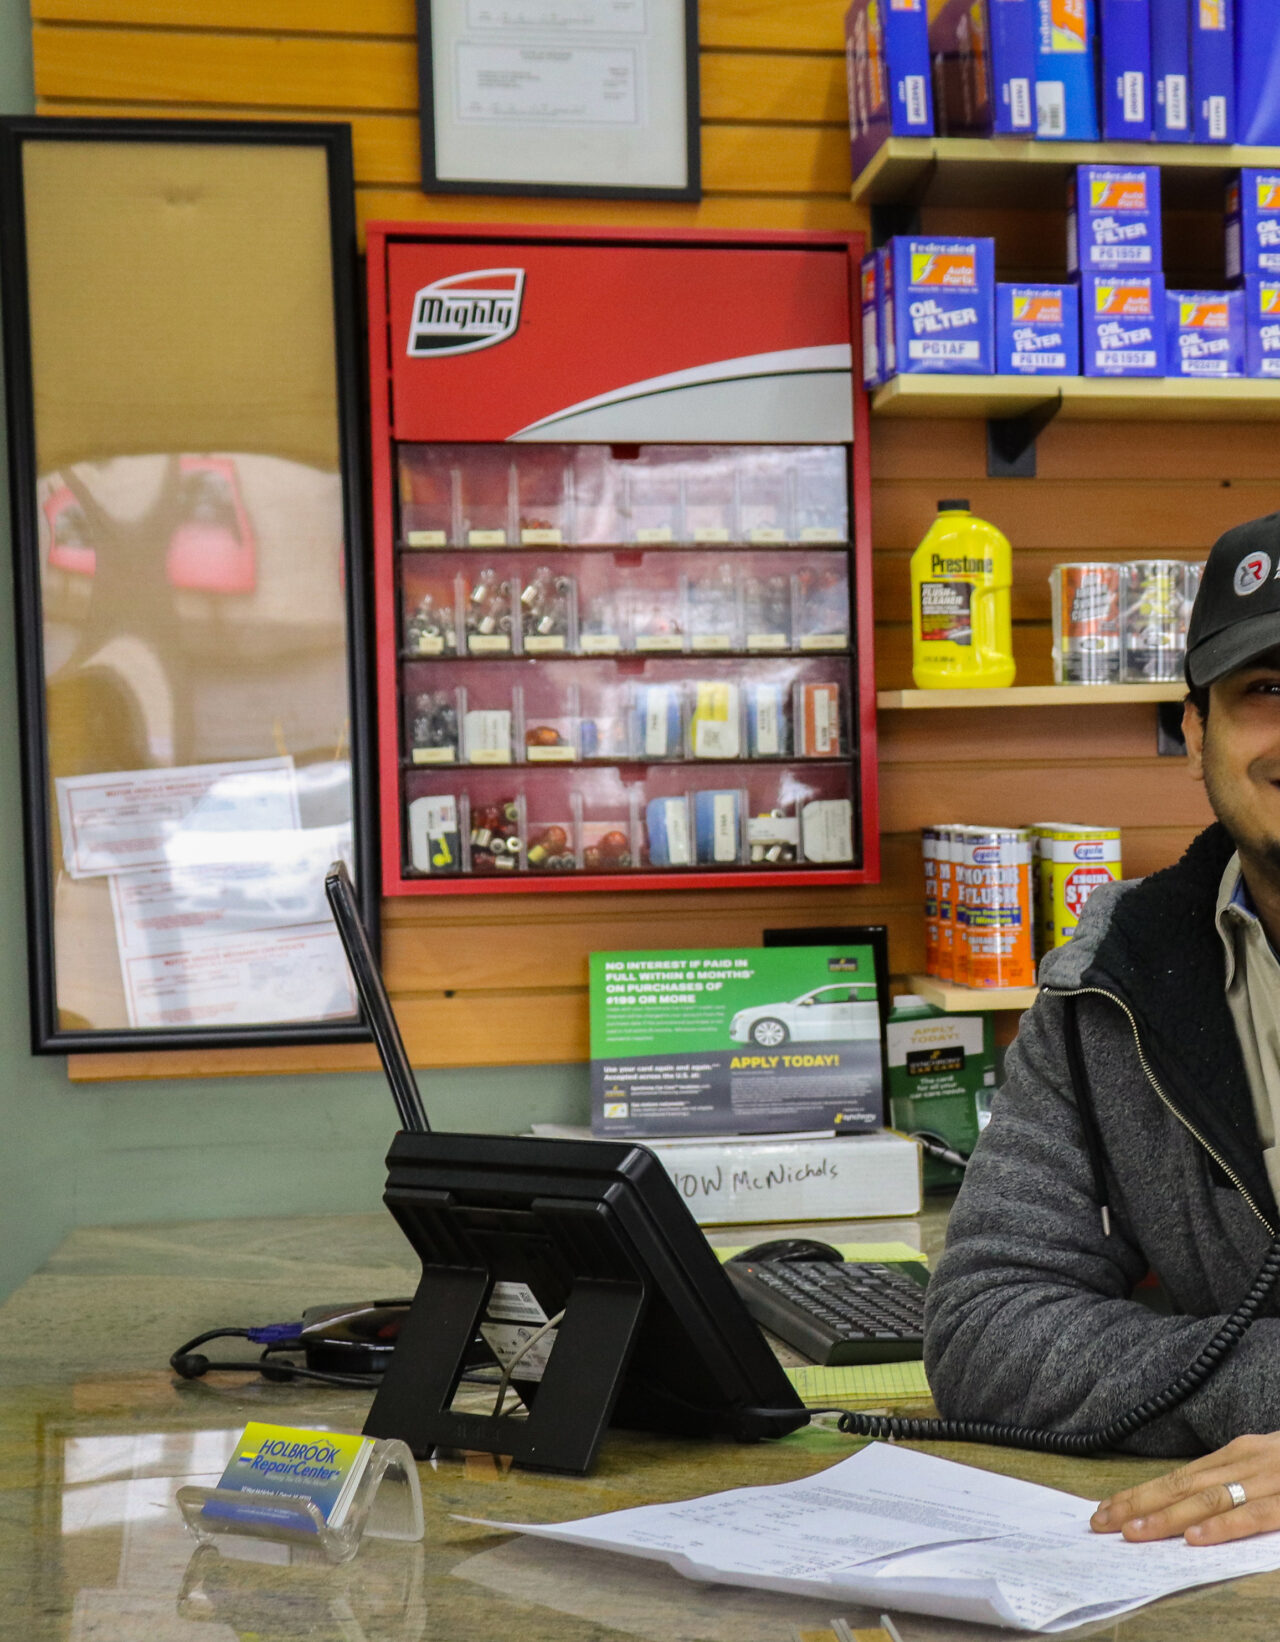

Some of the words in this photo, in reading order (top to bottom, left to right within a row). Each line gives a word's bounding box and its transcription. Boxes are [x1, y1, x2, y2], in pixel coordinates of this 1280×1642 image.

[1090, 171, 1147, 182] Federated
[1092, 217, 1119, 231] OIL
[1256, 219, 1280, 233] OIL
[1095, 223, 1147, 244] FILTER
[910, 243, 977, 254] Federated
[947, 266, 973, 275] Auto
[943, 274, 974, 284] Parts
[1094, 277, 1152, 286] Federated
[1011, 289, 1063, 298] Federated
[418, 298, 513, 330] Mighty
[909, 299, 943, 317] OIL
[914, 307, 978, 335] FILTER
[1012, 328, 1039, 342] OIL
[1097, 322, 1124, 337] OIL
[1015, 333, 1062, 352] FILTER
[1100, 328, 1152, 350] FILTER
[1179, 333, 1204, 347] OIL
[922, 341, 967, 356] PG1AF
[1182, 338, 1230, 359] FILTER
[932, 553, 993, 574] Prestone
[922, 595, 963, 605] CLEANER
[964, 866, 1020, 885] MOTOR
[966, 885, 1018, 905] FLUSH
[605, 962, 625, 971] NO
[626, 960, 687, 970] INTEREST
[689, 960, 701, 968] IF
[703, 959, 733, 968] PAID
[734, 959, 748, 968] IN
[605, 972, 637, 982] FULL
[639, 971, 684, 981] WITHIN
[686, 971, 695, 979] 6
[605, 984, 625, 993] ON
[627, 982, 704, 993] PURCHASES
[706, 982, 723, 991] OF
[638, 995, 657, 1004] OR
[659, 994, 697, 1004] MORE
[914, 1025, 955, 1035] APPLY
[911, 1033, 960, 1044] TODAY!
[730, 1055, 779, 1069] APPLY
[782, 1054, 840, 1068] TODAY!
[733, 1158, 839, 1193] McNichols
[258, 1439, 342, 1464] HOLBROOK
[250, 1455, 337, 1480] RepairCenter
